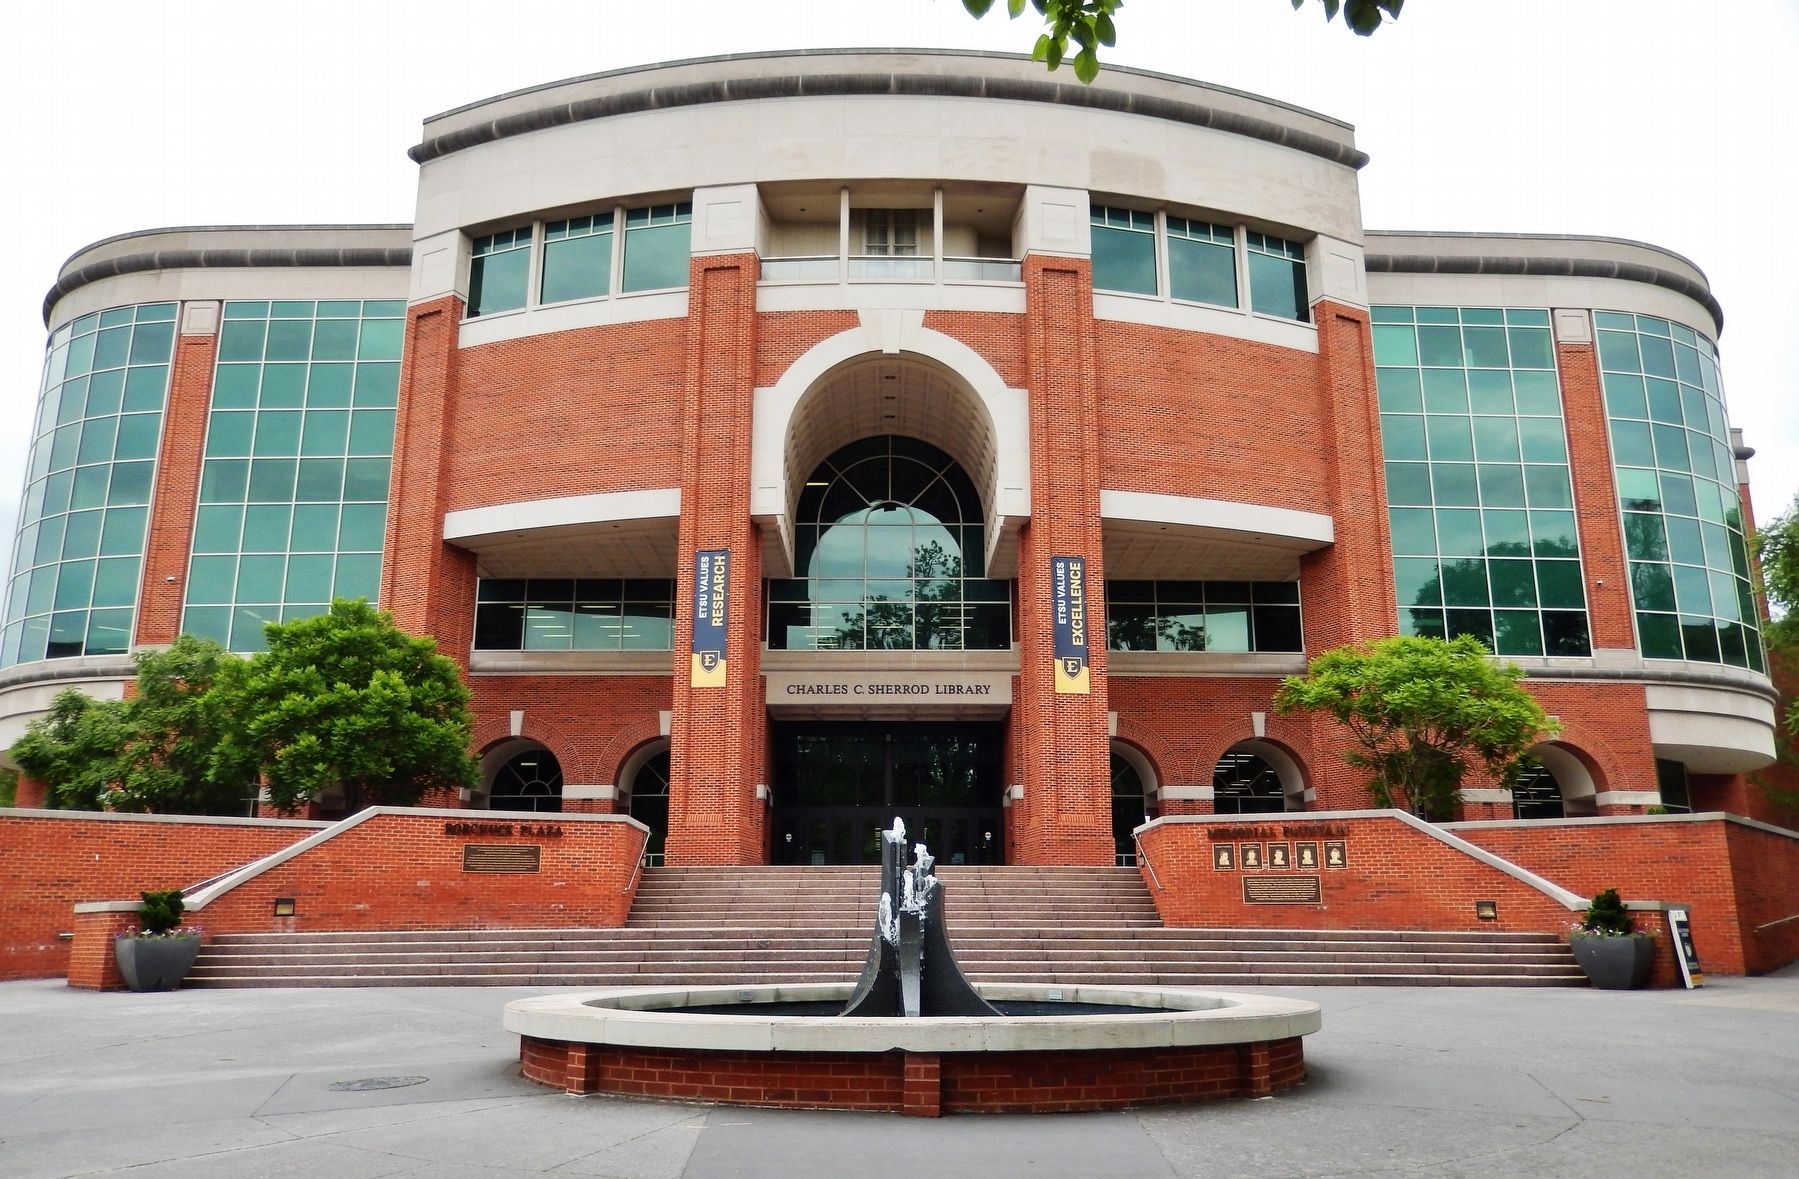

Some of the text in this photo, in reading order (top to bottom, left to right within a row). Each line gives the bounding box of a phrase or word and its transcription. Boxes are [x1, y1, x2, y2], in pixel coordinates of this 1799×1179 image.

[699, 556, 709, 618] ETSU VALUES
[712, 555, 725, 626] RESEARCH
[1056, 562, 1067, 624] ETSU VALUES
[1069, 562, 1083, 645] EXCELLENCE
[704, 654, 715, 666] E
[786, 684, 849, 695] CHARLES
[868, 684, 930, 695] SHERROD
[935, 684, 992, 695] LIBRARY
[520, 825, 564, 838] PLAZA
